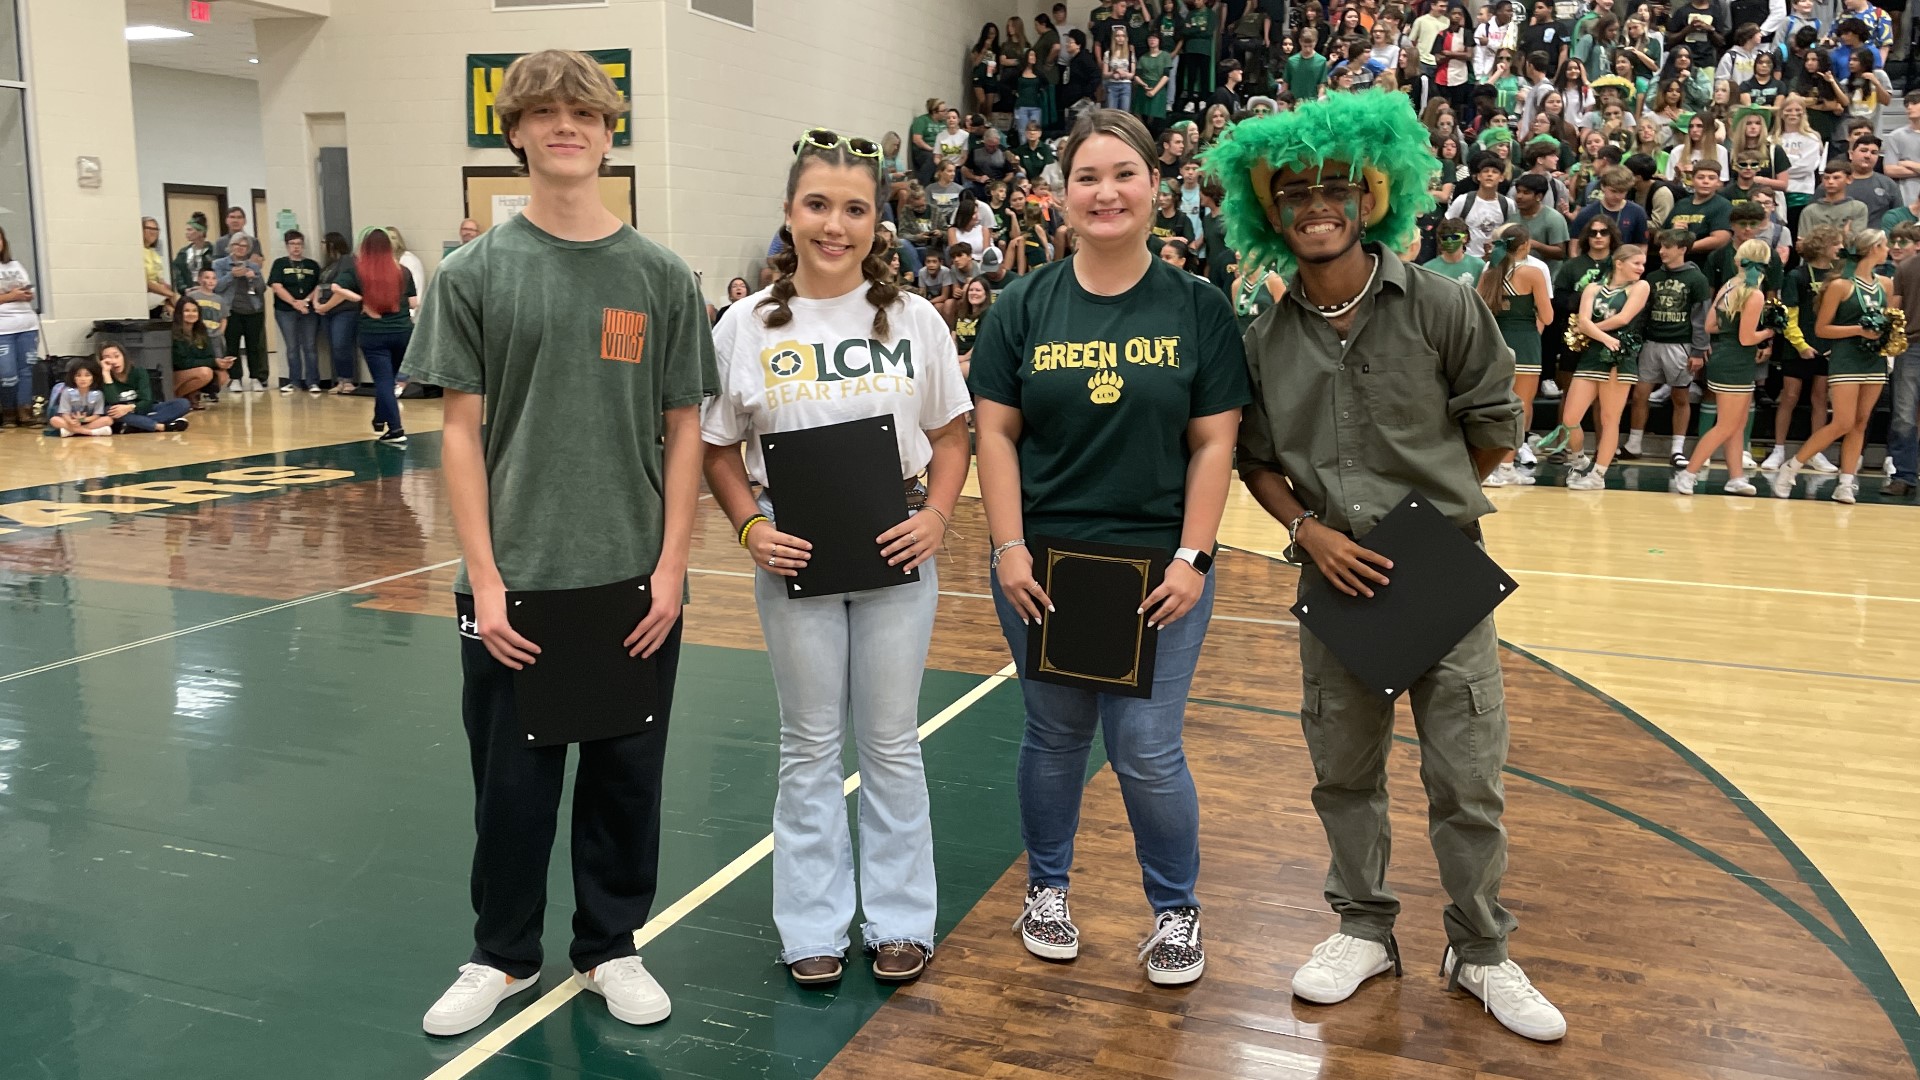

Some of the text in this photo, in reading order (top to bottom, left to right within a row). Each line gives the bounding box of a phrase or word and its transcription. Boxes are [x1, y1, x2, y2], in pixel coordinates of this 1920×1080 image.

[1655, 279, 1686, 293] LCM
[1660, 295, 1674, 307] VS
[811, 338, 914, 382] LCM
[1032, 335, 1181, 374] GREEN OUT
[765, 374, 915, 411] BEAR FACTS
[1096, 391, 1115, 399] LCM
